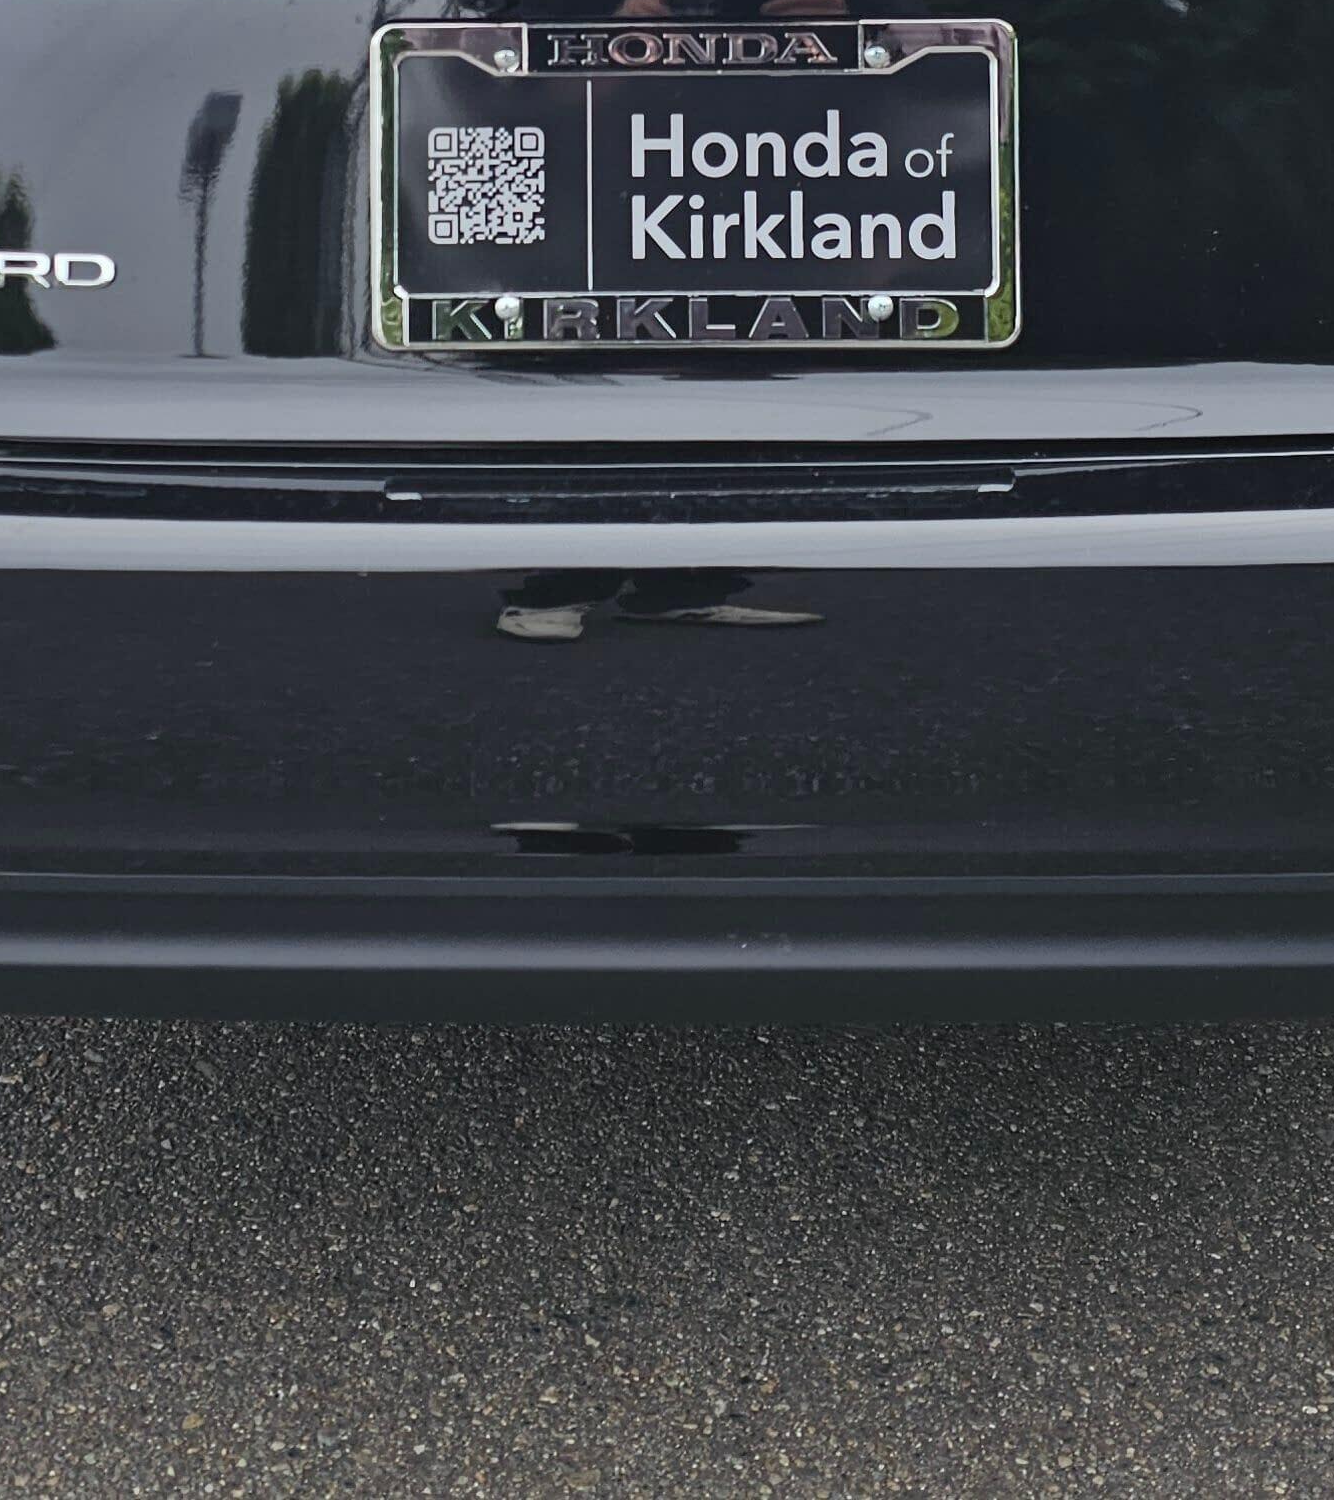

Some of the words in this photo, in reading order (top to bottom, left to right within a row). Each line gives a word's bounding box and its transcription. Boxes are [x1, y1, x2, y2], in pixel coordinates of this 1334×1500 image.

[546, 31, 839, 68] HONDA
[630, 109, 889, 178] Honda
[904, 133, 955, 178] of
[630, 190, 957, 260] Kirkland
